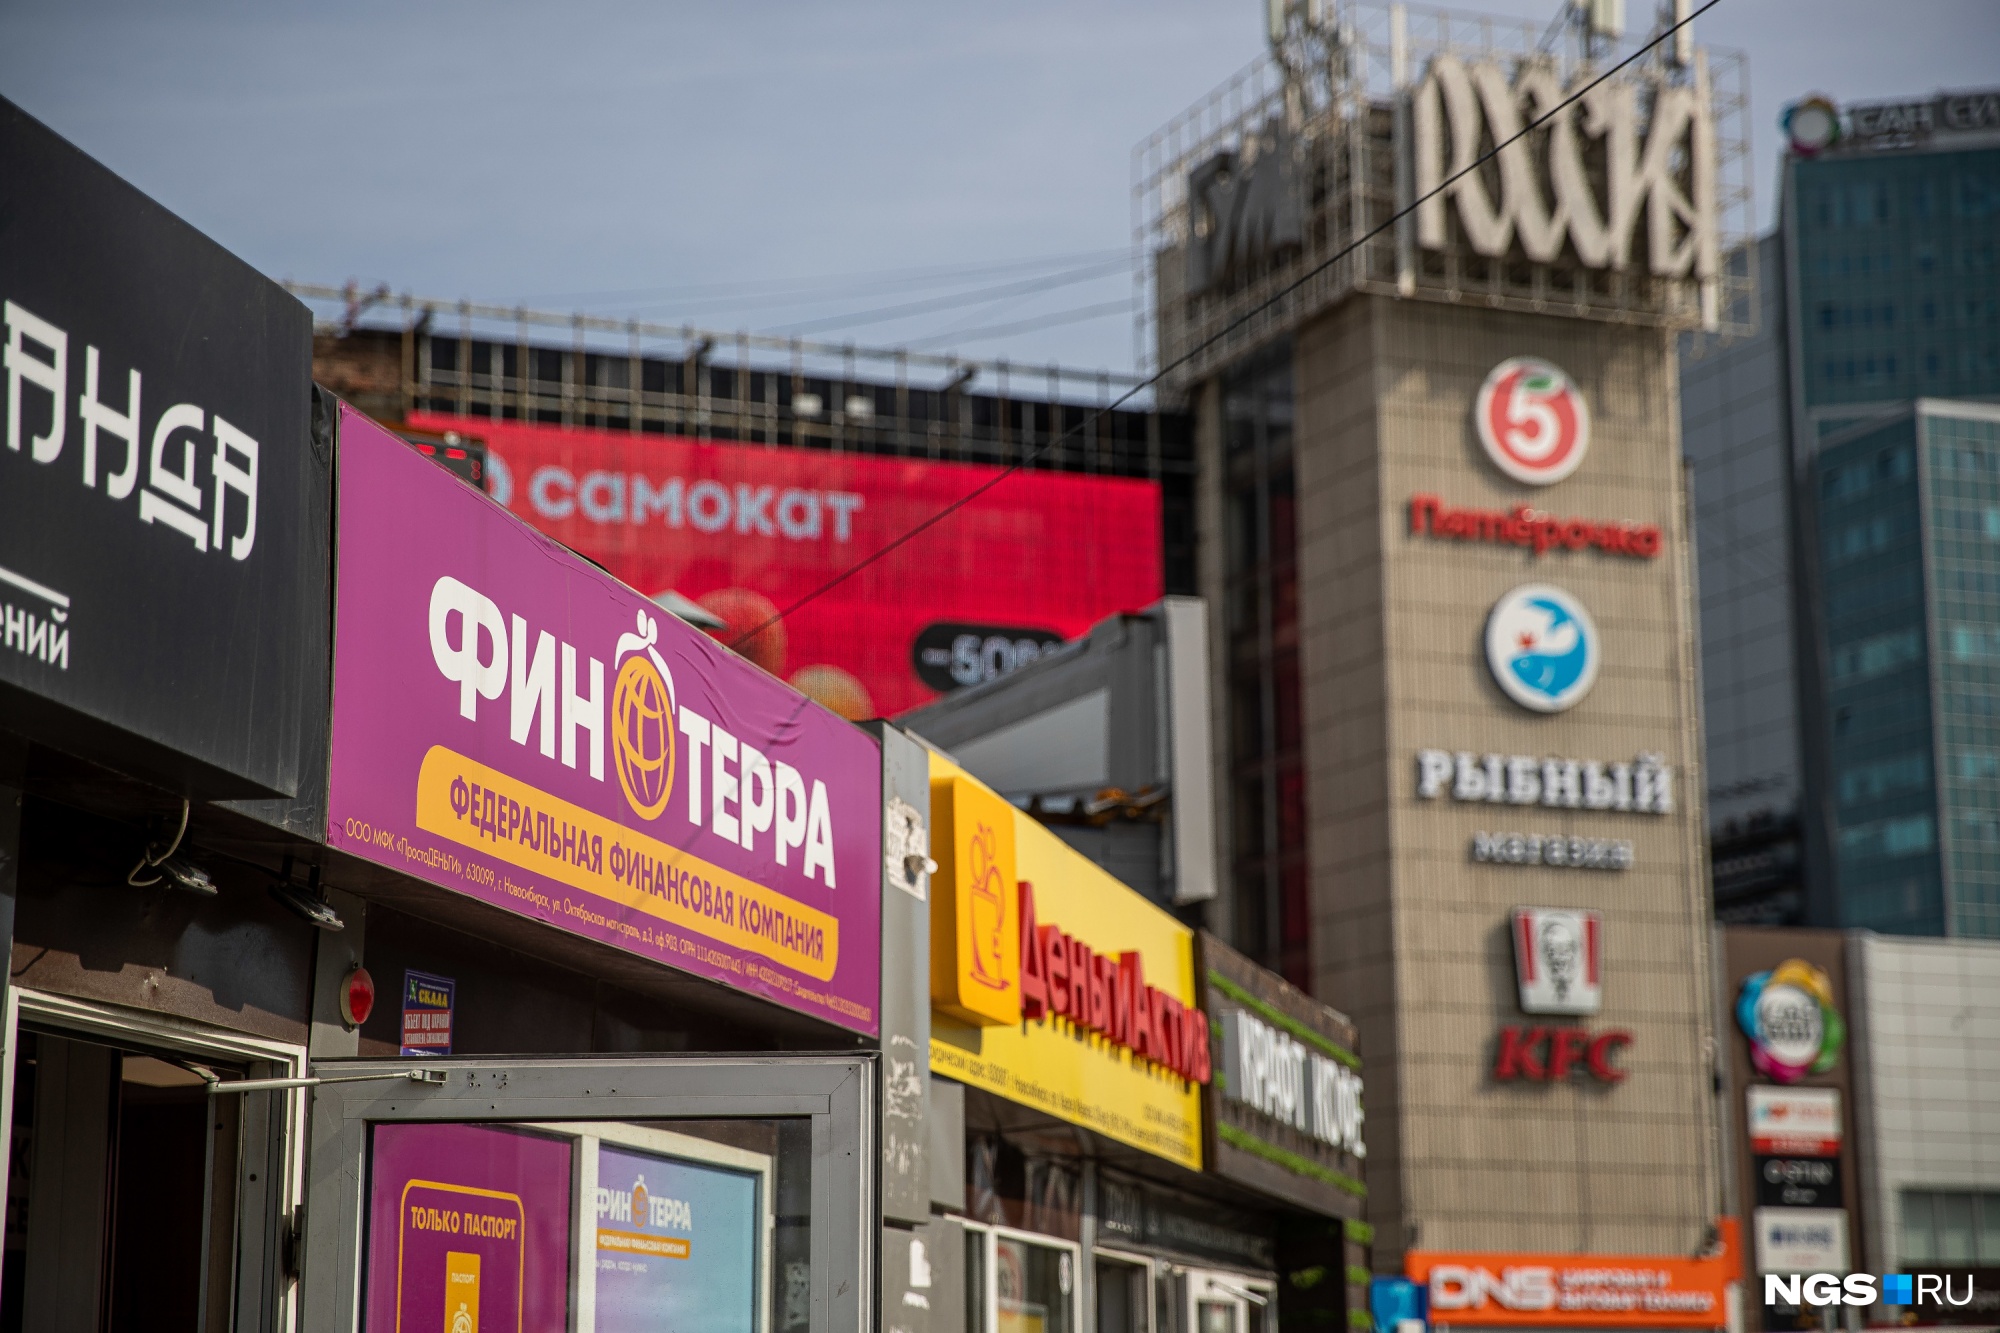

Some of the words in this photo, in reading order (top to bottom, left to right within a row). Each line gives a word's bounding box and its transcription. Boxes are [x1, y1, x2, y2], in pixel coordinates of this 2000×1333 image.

[528, 464, 866, 544] самокат
[0, 603, 69, 670] ний
[1416, 748, 1674, 815] РЫБНЫЙ
[346, 817, 371, 843] ООО
[372, 828, 395, 852] МФК
[396, 837, 464, 880] «ПростоДЕНЬГИ»,
[504, 876, 550, 911] Новосибирск,
[450, 774, 603, 876] ФЕДЕРАЛЬНАЯ
[609, 841, 735, 927] ФИНАНСОВАЯ
[739, 894, 824, 963] КОМПАНИЯ
[1471, 831, 1634, 871] магазин
[1495, 1024, 1634, 1084] KFC
[410, 1206, 460, 1234] ТОЛЬКО
[463, 1212, 517, 1240] ПАСПОРТ
[1428, 1264, 1556, 1311] DNS
